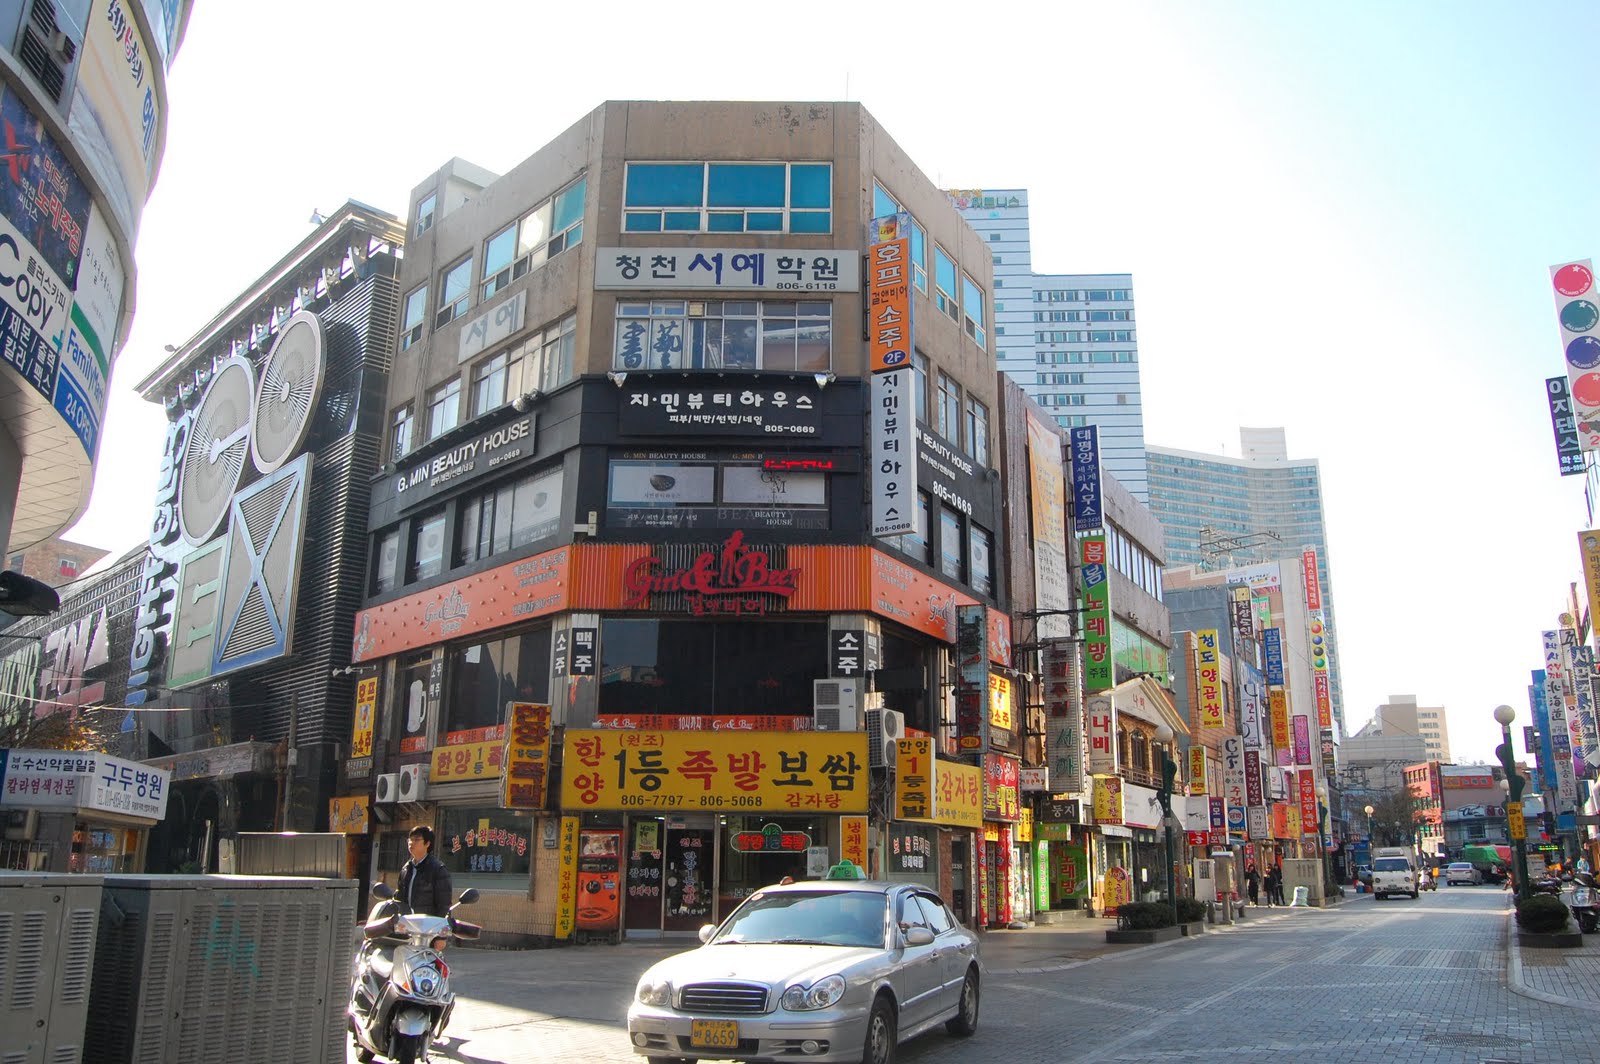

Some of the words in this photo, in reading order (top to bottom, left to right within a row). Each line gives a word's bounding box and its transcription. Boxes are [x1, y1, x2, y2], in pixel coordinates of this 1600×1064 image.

[35, 181, 82, 257] 노래주점
[616, 254, 677, 280] 청천
[687, 252, 765, 286] 서예
[776, 256, 840, 282] 학원
[876, 244, 902, 288] 호프
[26, 255, 67, 313] 플러스카피
[776, 281, 837, 291] 806-6118
[872, 286, 908, 306] 걸앤비어
[466, 295, 521, 350] 서예
[878, 305, 901, 348] 소주
[8, 311, 31, 343] 제본
[37, 340, 57, 374] 출력
[887, 352, 902, 365] 2F
[3, 336, 27, 372] 칼라
[33, 362, 51, 396] 팩스
[65, 392, 76, 421] 24
[764, 424, 815, 434] 805-0669
[410, 464, 430, 486] MIN
[432, 440, 480, 475] BEAUTY
[482, 419, 531, 453] HOUSE
[649, 452, 679, 460] BEAUTY
[681, 452, 707, 460] HOUSE
[923, 432, 951, 460] BEAUTY
[951, 453, 974, 476] HOUSE
[1076, 429, 1095, 464] 태평양
[932, 480, 973, 516] 805-0669
[1080, 482, 1097, 516] 사무소
[874, 522, 911, 533] 805-0669
[1086, 592, 1107, 663] 노래방
[554, 632, 568, 675] 소주
[575, 631, 593, 673] 맥주
[838, 632, 859, 675] 소주
[1199, 633, 1216, 663] 청도
[989, 675, 1007, 693] 호프
[1089, 667, 1108, 679] 주점
[358, 682, 376, 704] 호프
[1201, 668, 1220, 717] 양곱창
[1547, 680, 1565, 722] 北海道
[994, 708, 1009, 725] 소주
[357, 730, 372, 753] 소주
[618, 732, 665, 748] (원조)
[898, 740, 929, 755] 한양
[1092, 715, 1111, 754] 나비
[6, 777, 76, 796] 칼라염색전문
[101, 762, 163, 801] 구두병원
[573, 735, 605, 805] 한양
[613, 749, 670, 792] 1등
[676, 749, 767, 792] 족발
[771, 750, 862, 792] 보쌈
[901, 756, 927, 788] 1등
[620, 794, 684, 807] 806-7797
[700, 795, 763, 807] 806-5068
[784, 792, 842, 809] 감자탕
[901, 791, 927, 818] 족발
[941, 771, 979, 807] 감자탕
[985, 783, 1017, 818] 노래방
[563, 821, 574, 866] 냉채족발
[560, 870, 572, 904] 감자탕
[629, 867, 660, 879] 감자탕
[1061, 852, 1077, 895] 노래방
[559, 907, 570, 931] 보쌈
[705, 1029, 736, 1046] 8659
